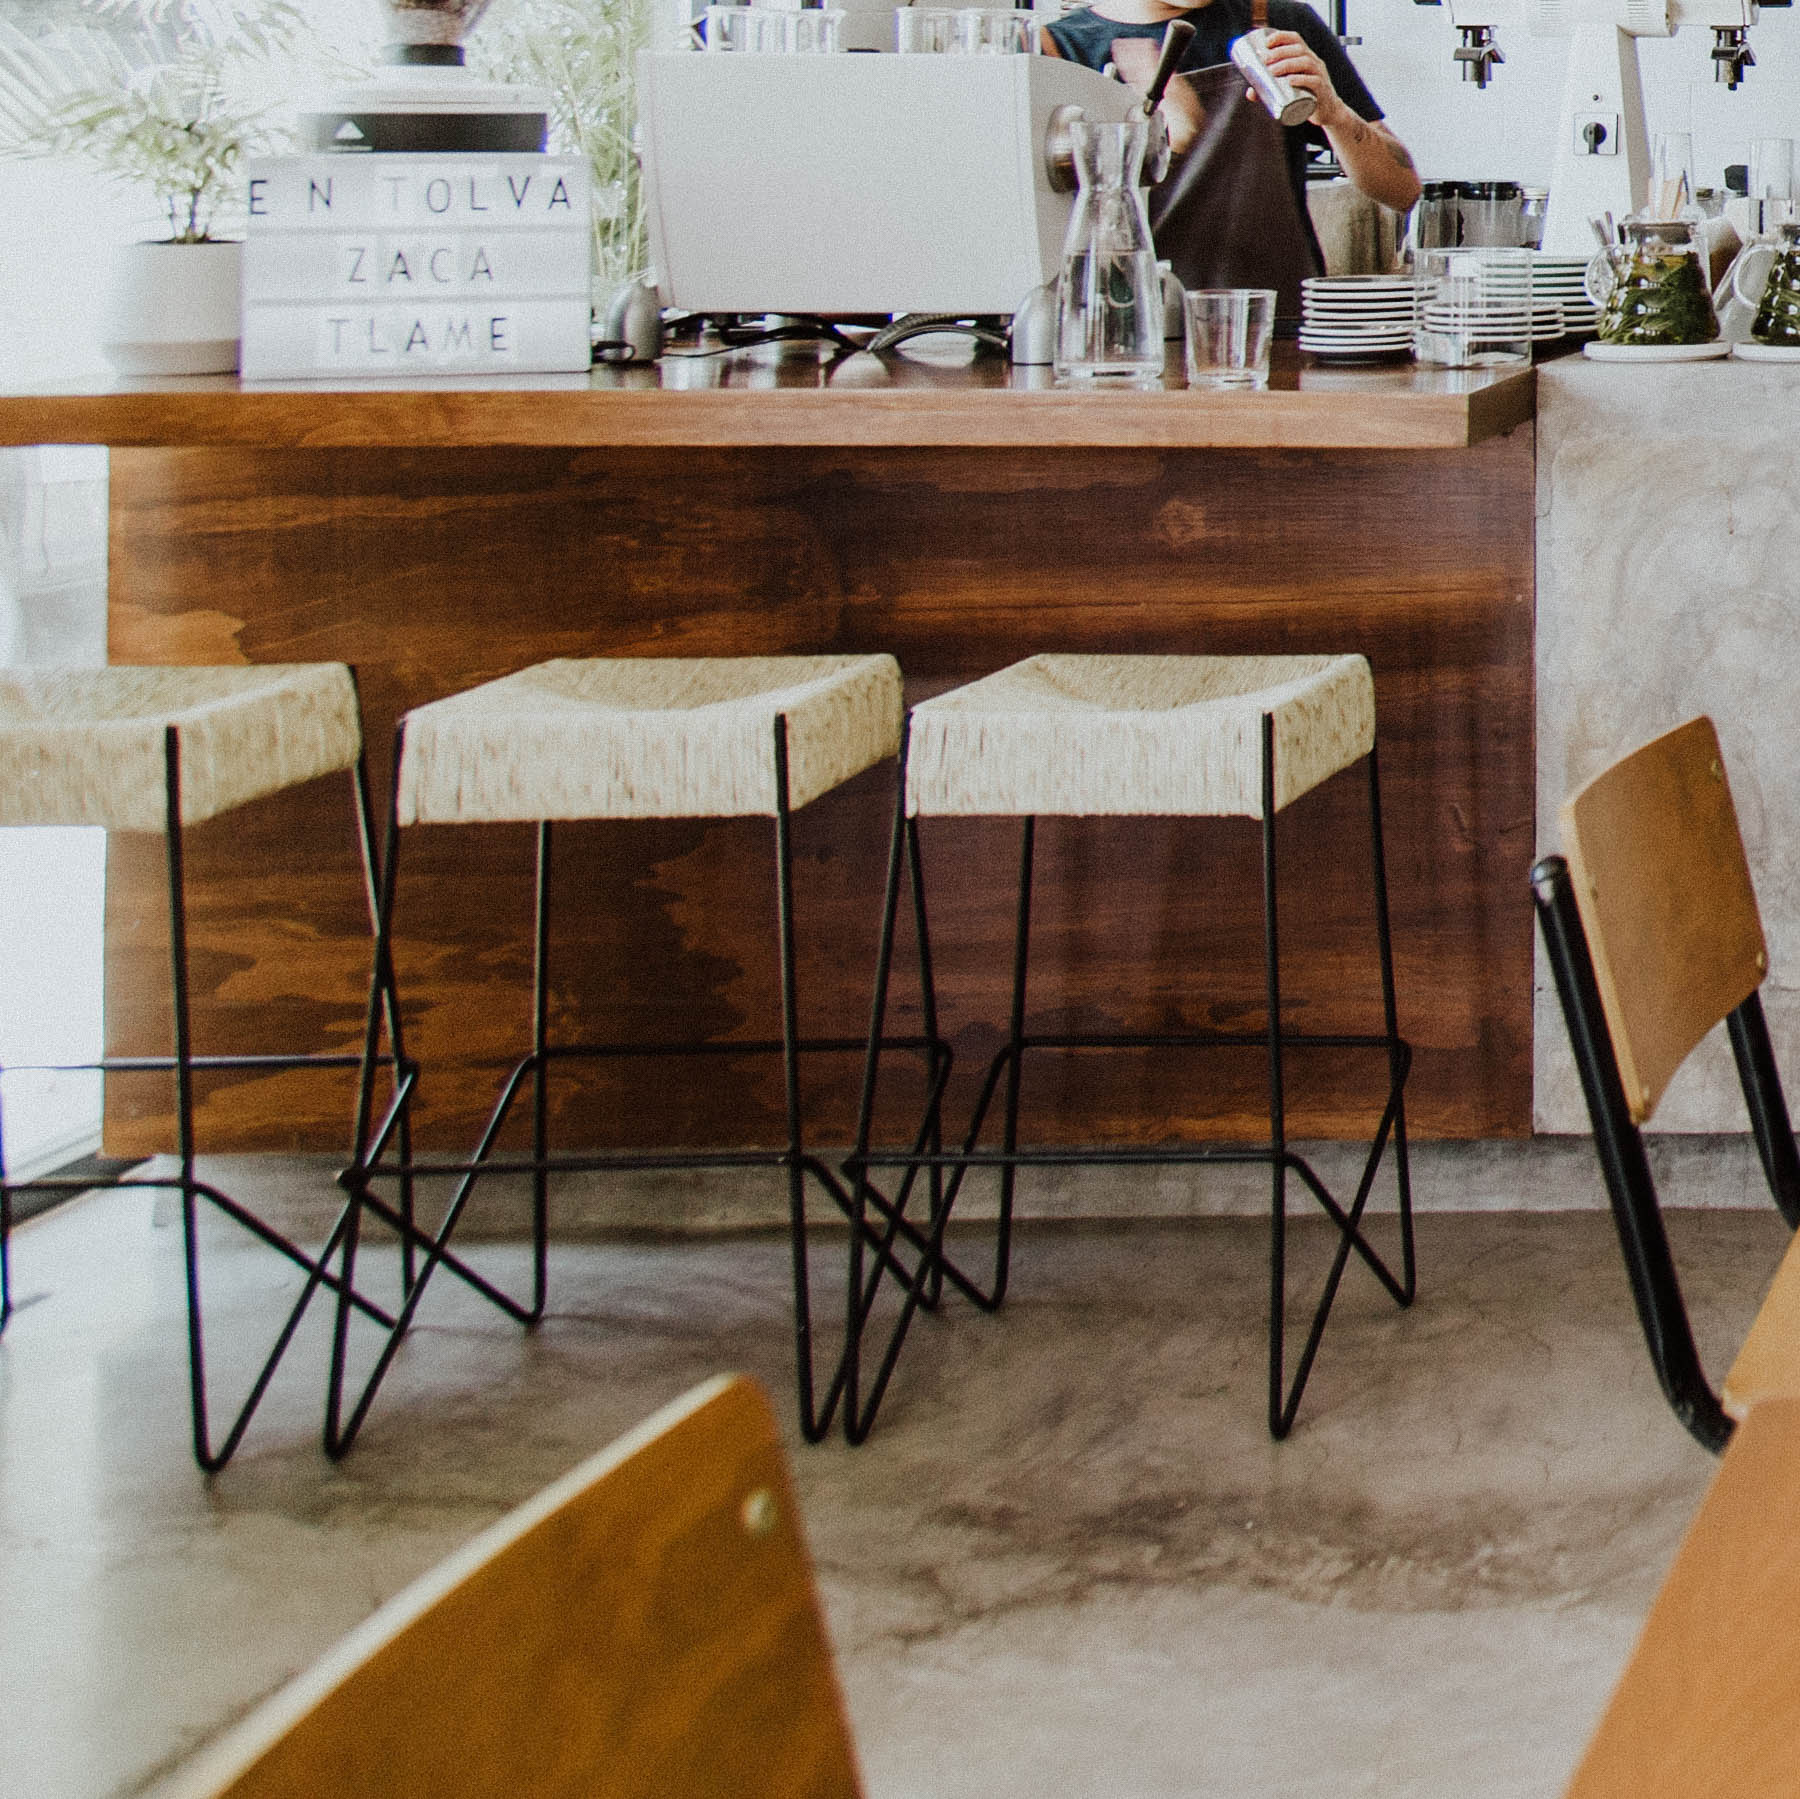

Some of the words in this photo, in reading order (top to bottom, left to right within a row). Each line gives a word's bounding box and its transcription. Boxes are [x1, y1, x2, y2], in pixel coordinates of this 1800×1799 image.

[249, 177, 332, 215] EN
[383, 176, 571, 213] TOLVA
[348, 248, 493, 282] ZACA
[328, 317, 508, 353] TLAME
